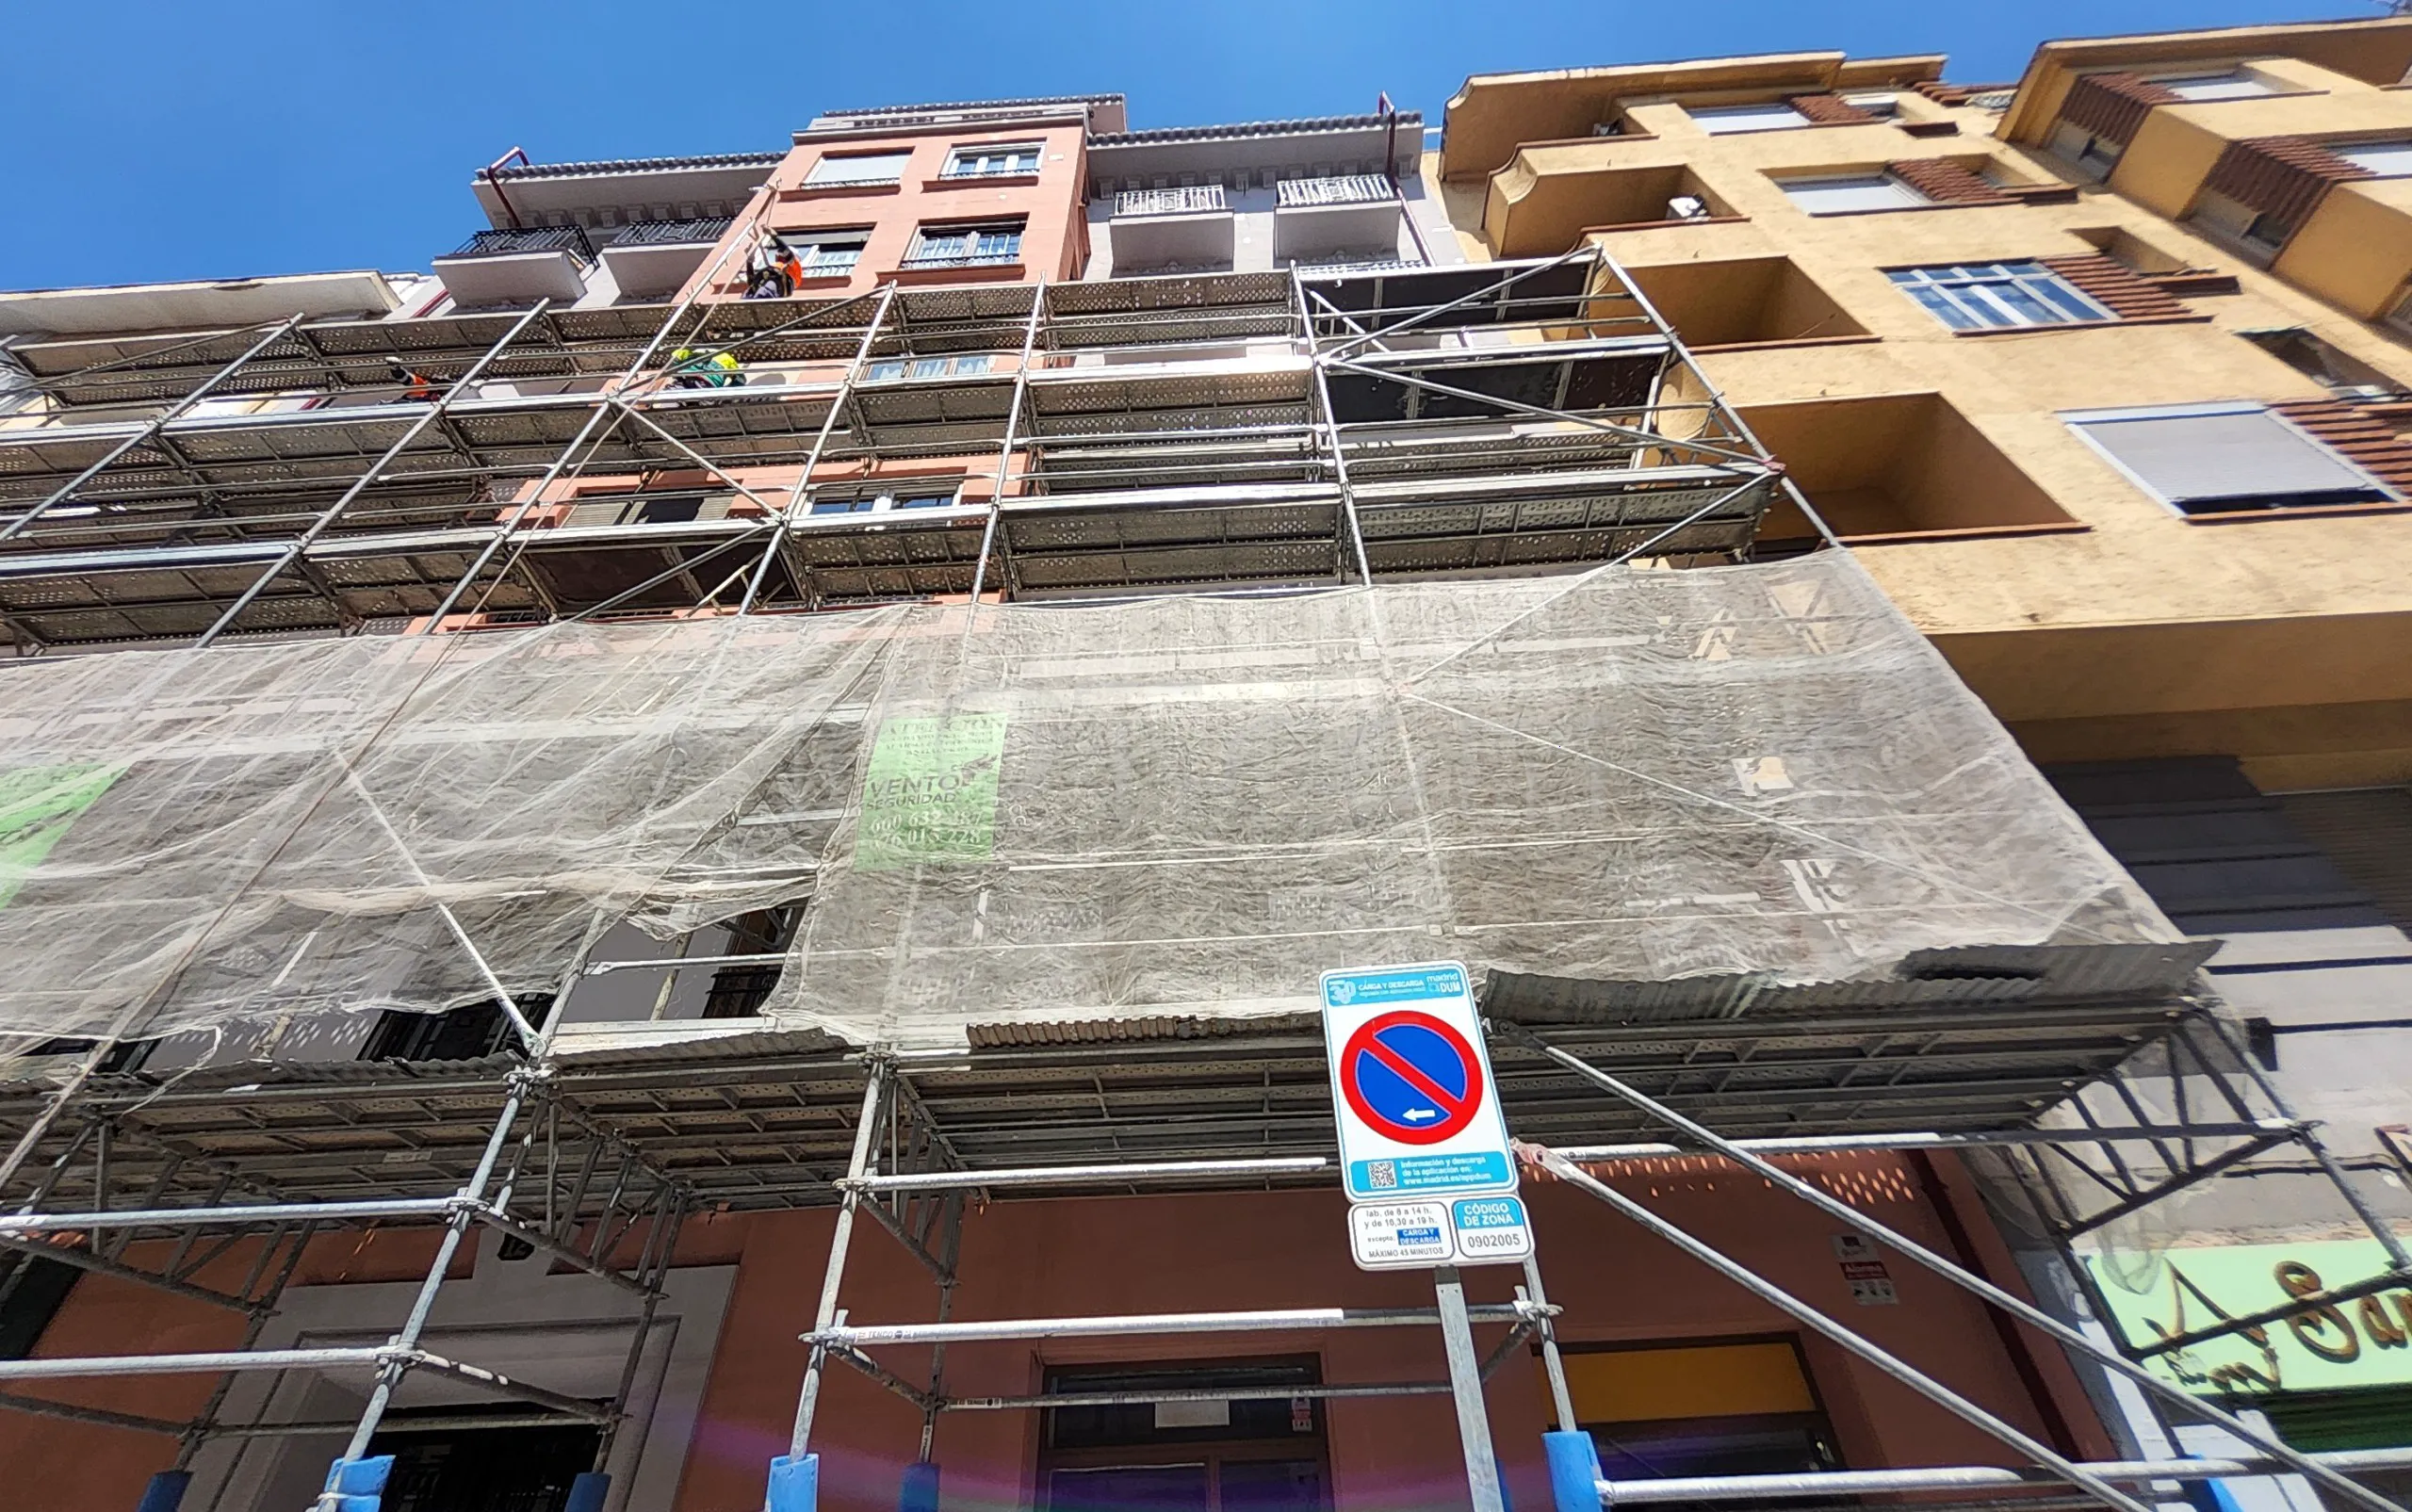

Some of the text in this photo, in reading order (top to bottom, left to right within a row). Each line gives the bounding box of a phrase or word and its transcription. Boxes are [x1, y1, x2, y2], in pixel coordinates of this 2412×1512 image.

[870, 773, 959, 798] VENTO
[866, 792, 957, 810] SEGURIDAD
[1358, 983, 1381, 991] CARGA
[1388, 980, 1425, 989] DESCARGA
[1426, 973, 1459, 983] madrid
[1440, 982, 1461, 993] DUM
[1401, 1160, 1444, 1168] Información
[1452, 1157, 1486, 1165] descarga
[1421, 1165, 1459, 1176] aplicación
[1384, 1209, 1394, 1217] de
[1411, 1207, 1422, 1215] 14
[1424, 1206, 1432, 1214] h.
[1463, 1202, 1509, 1215] CÓDIGO
[1364, 1221, 1370, 1229] y
[1372, 1219, 1382, 1227] de
[1428, 1215, 1438, 1224] h.
[1463, 1213, 1515, 1227] DE ZONA
[1399, 1236, 1440, 1245] DESCARGA
[1467, 1233, 1521, 1248] 0902005
[1368, 1249, 1399, 1258] MÁXIMO
[1410, 1246, 1444, 1256] MINUTOS
[2273, 1260, 2412, 1363] Sa
